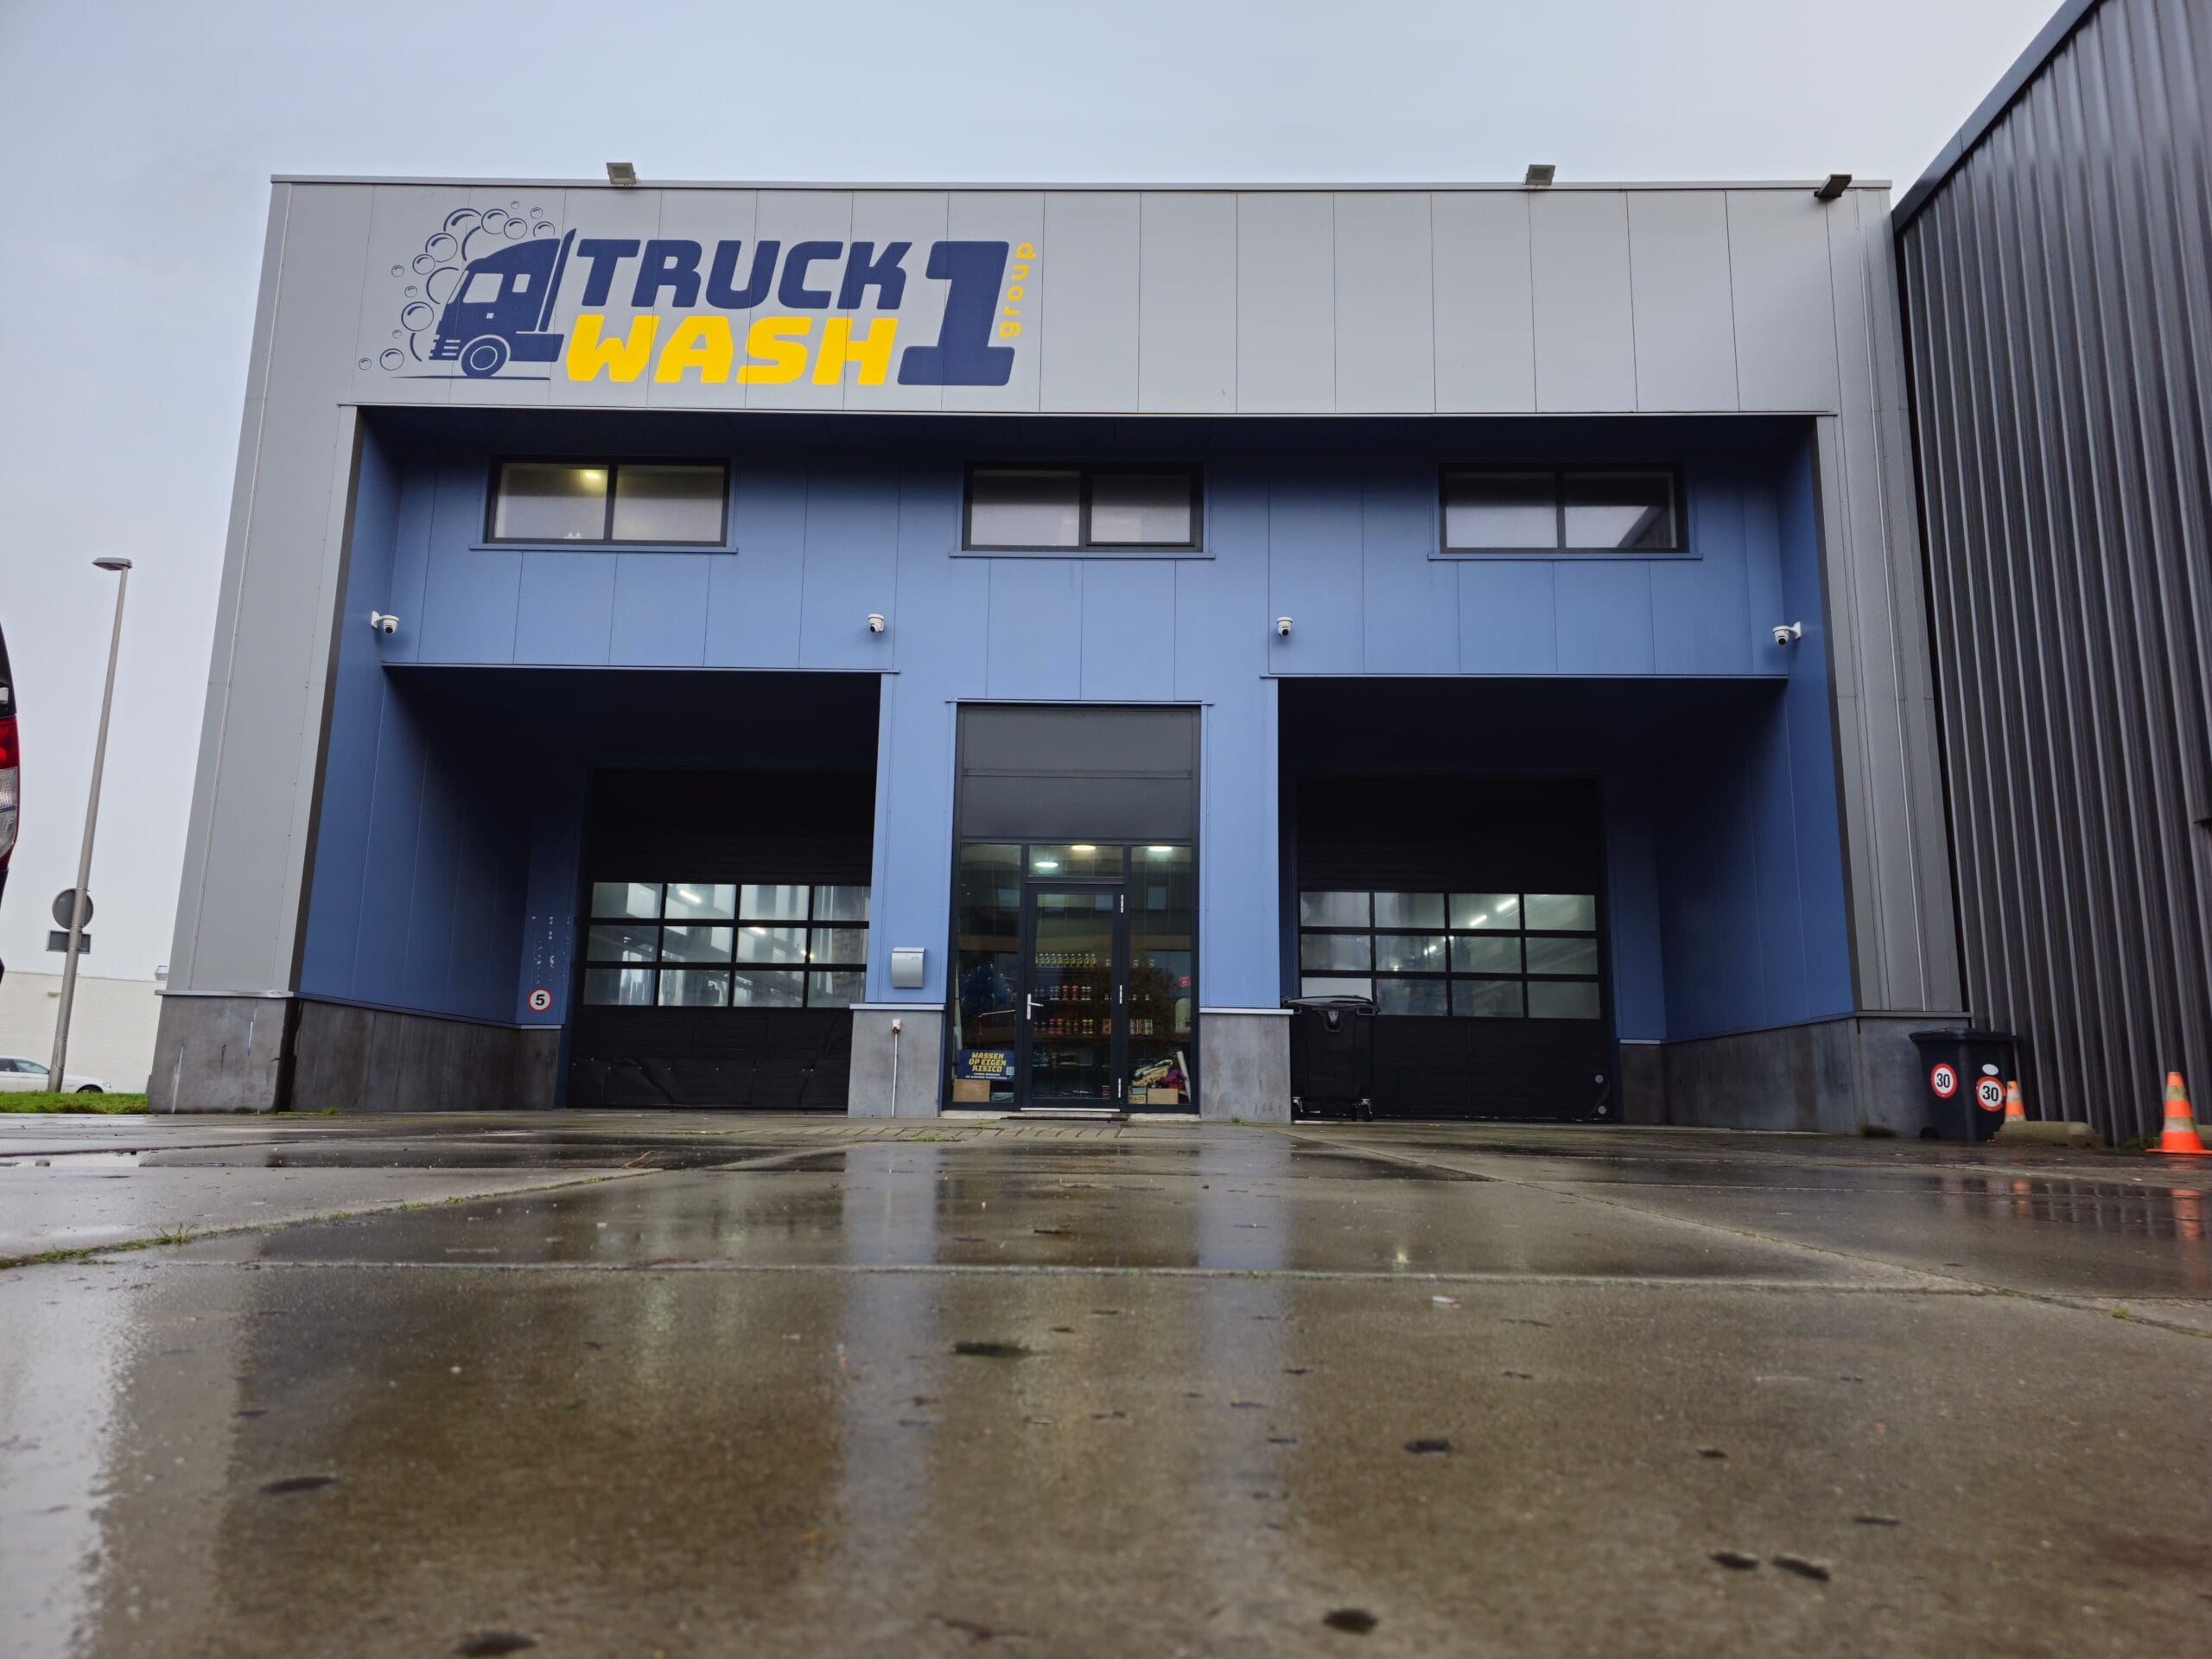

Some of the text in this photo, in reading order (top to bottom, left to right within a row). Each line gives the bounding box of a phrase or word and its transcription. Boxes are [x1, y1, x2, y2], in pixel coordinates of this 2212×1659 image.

[575, 238, 912, 309] TRUCK
[999, 242, 1037, 339] group
[898, 241, 1014, 386] 1
[565, 313, 899, 386] WASH
[535, 994, 545, 1006] 5
[1936, 1073, 1950, 1088] 30
[1982, 1085, 1999, 1102] 30
